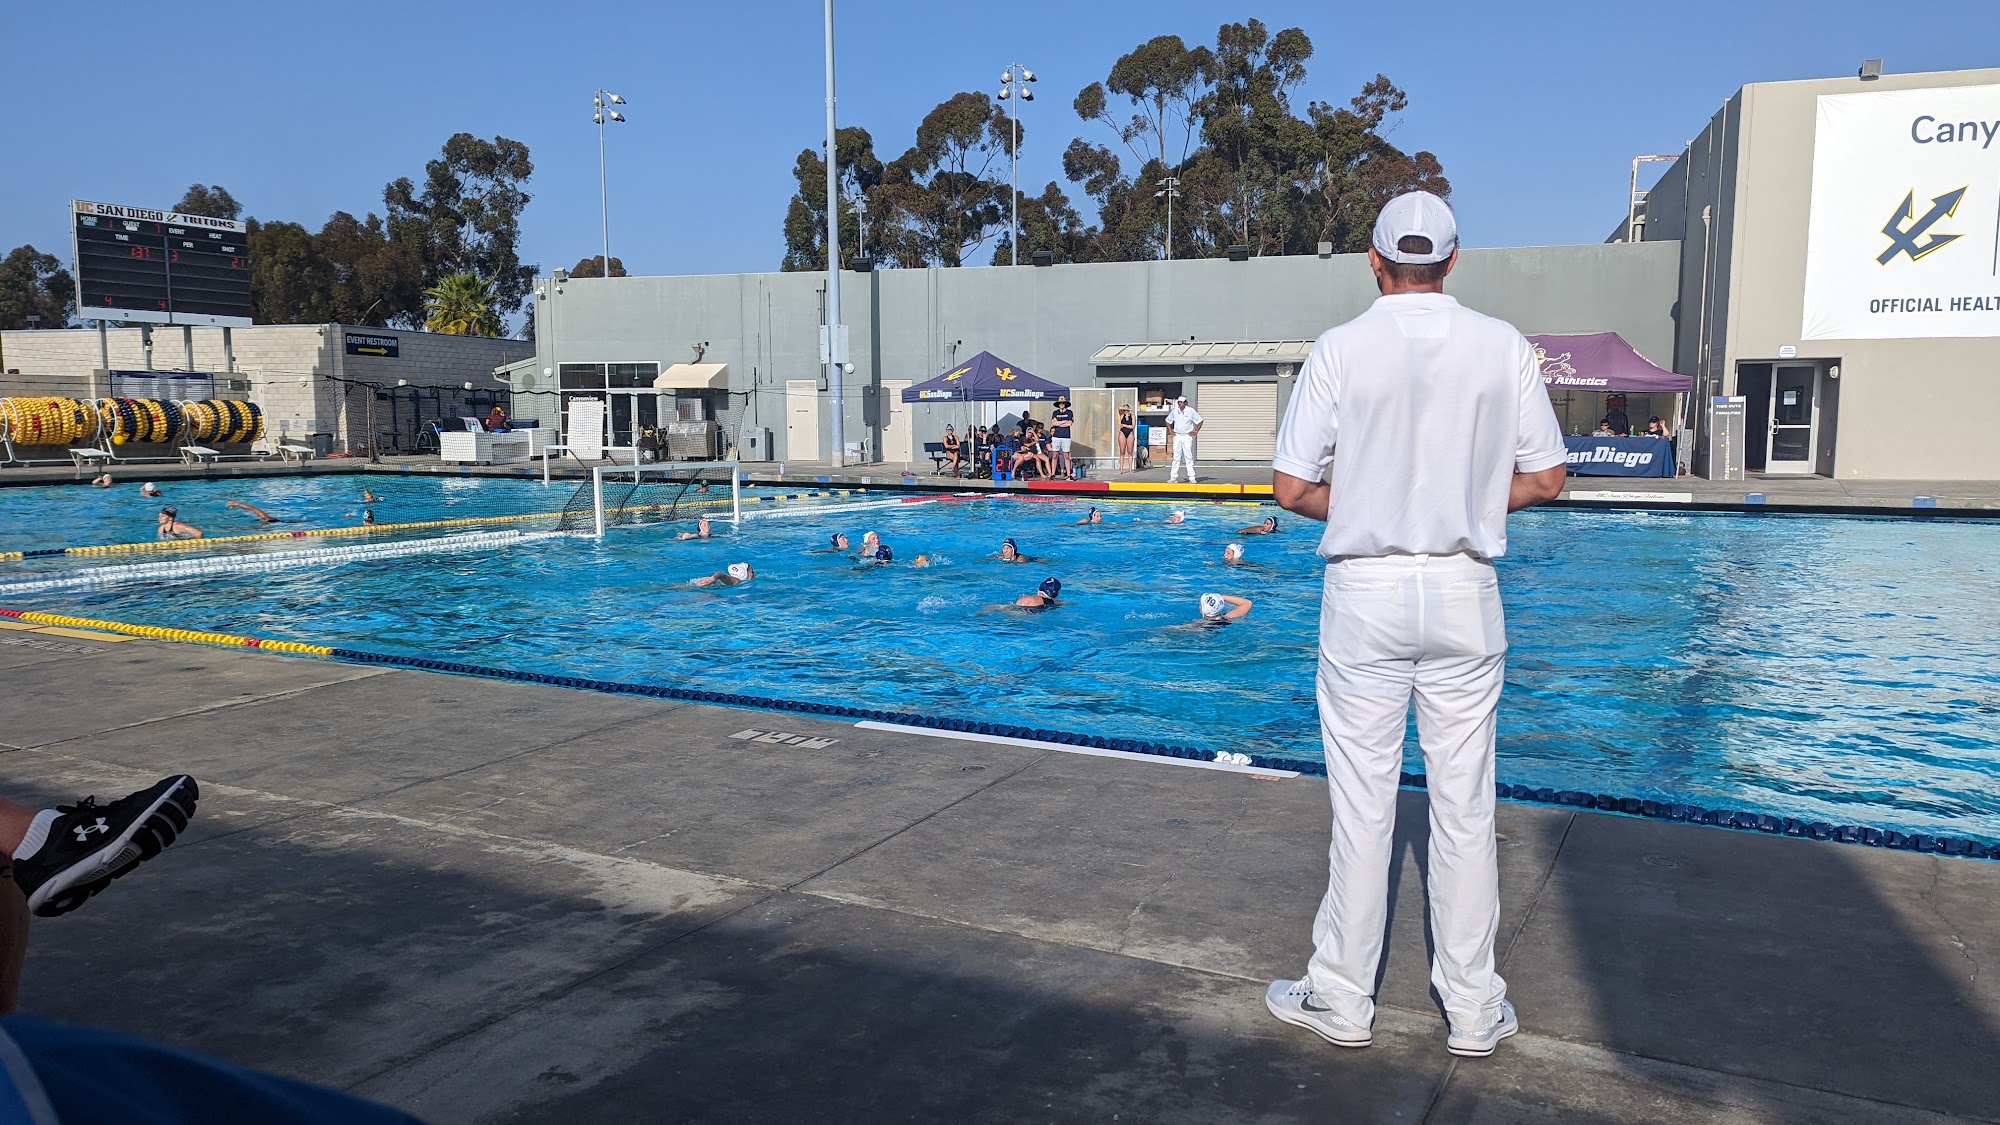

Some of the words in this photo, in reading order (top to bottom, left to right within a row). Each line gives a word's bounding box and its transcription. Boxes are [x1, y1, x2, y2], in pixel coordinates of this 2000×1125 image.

[1911, 115, 2000, 149] Cany
[76, 202, 94, 213] UC
[97, 204, 124, 216] SAN
[127, 208, 164, 221] DIEGO
[182, 215, 236, 229] TRITONS
[80, 215, 98, 223] HOME
[168, 228, 185, 236] EVENT
[1870, 298, 1943, 313] OFFICIAL
[346, 335, 366, 345] EVENT
[366, 337, 398, 347] RESTROOM
[1555, 377, 1608, 386] Athletics
